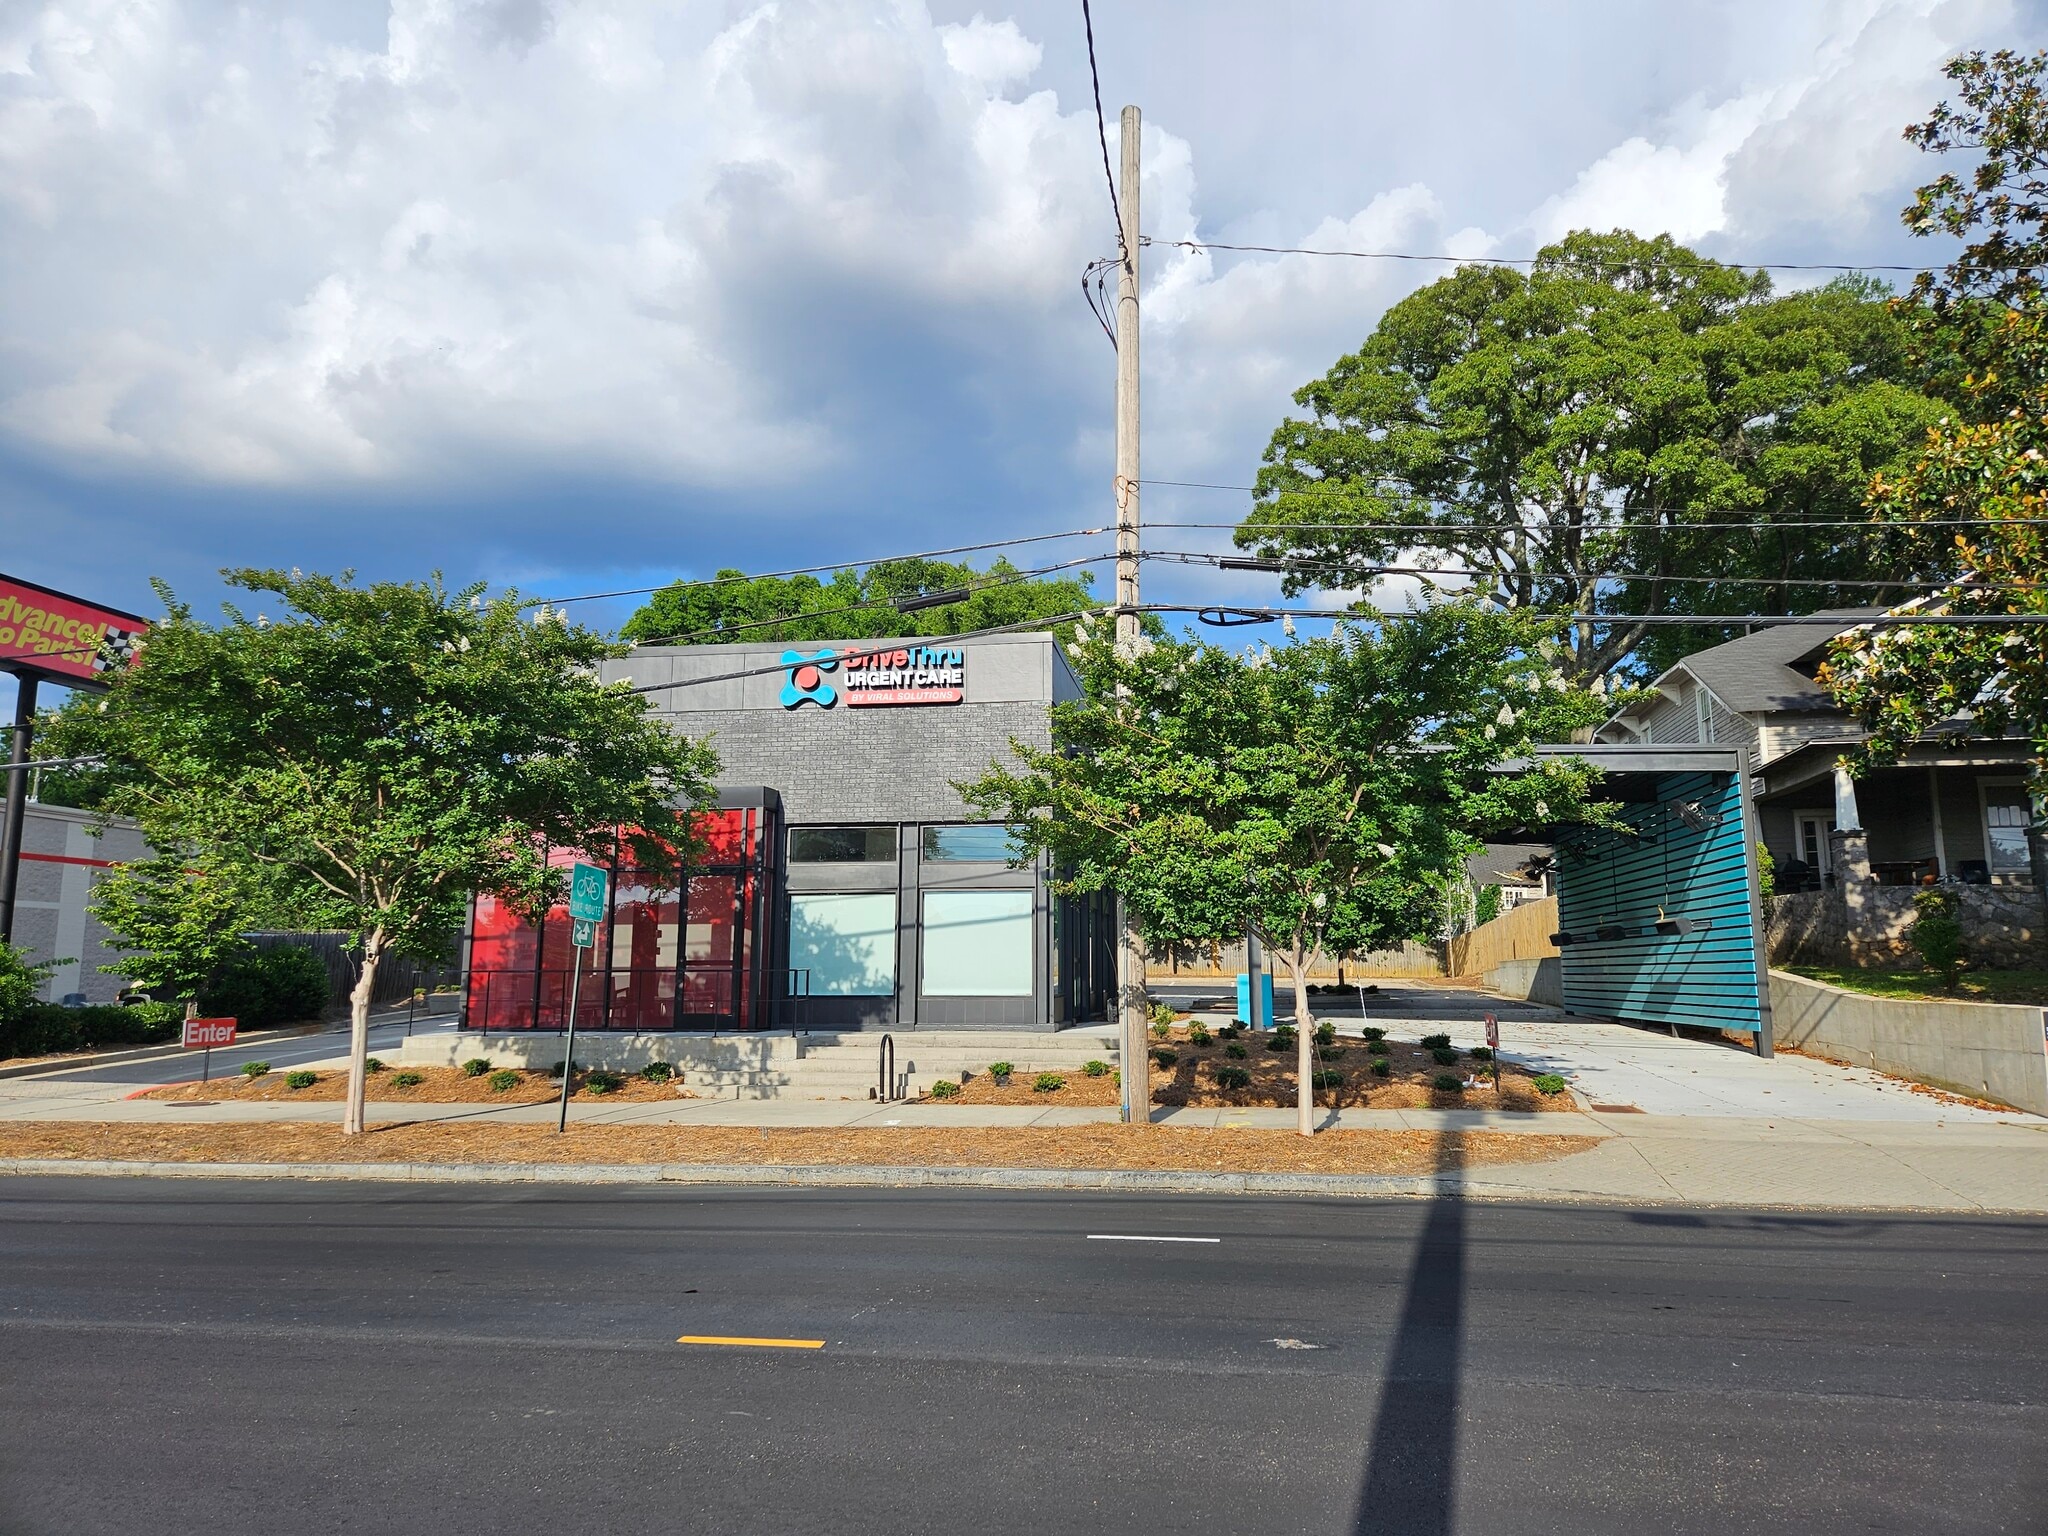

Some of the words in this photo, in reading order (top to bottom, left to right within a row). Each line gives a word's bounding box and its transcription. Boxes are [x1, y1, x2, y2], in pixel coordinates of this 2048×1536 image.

[844, 646, 962, 668] DriveThru
[844, 670, 915, 687] URGENT
[914, 669, 962, 685] CARE
[851, 693, 865, 702] BY
[867, 692, 894, 701] VIRAL
[897, 691, 953, 700] SOLUTIONS
[186, 1022, 235, 1043] Enter
